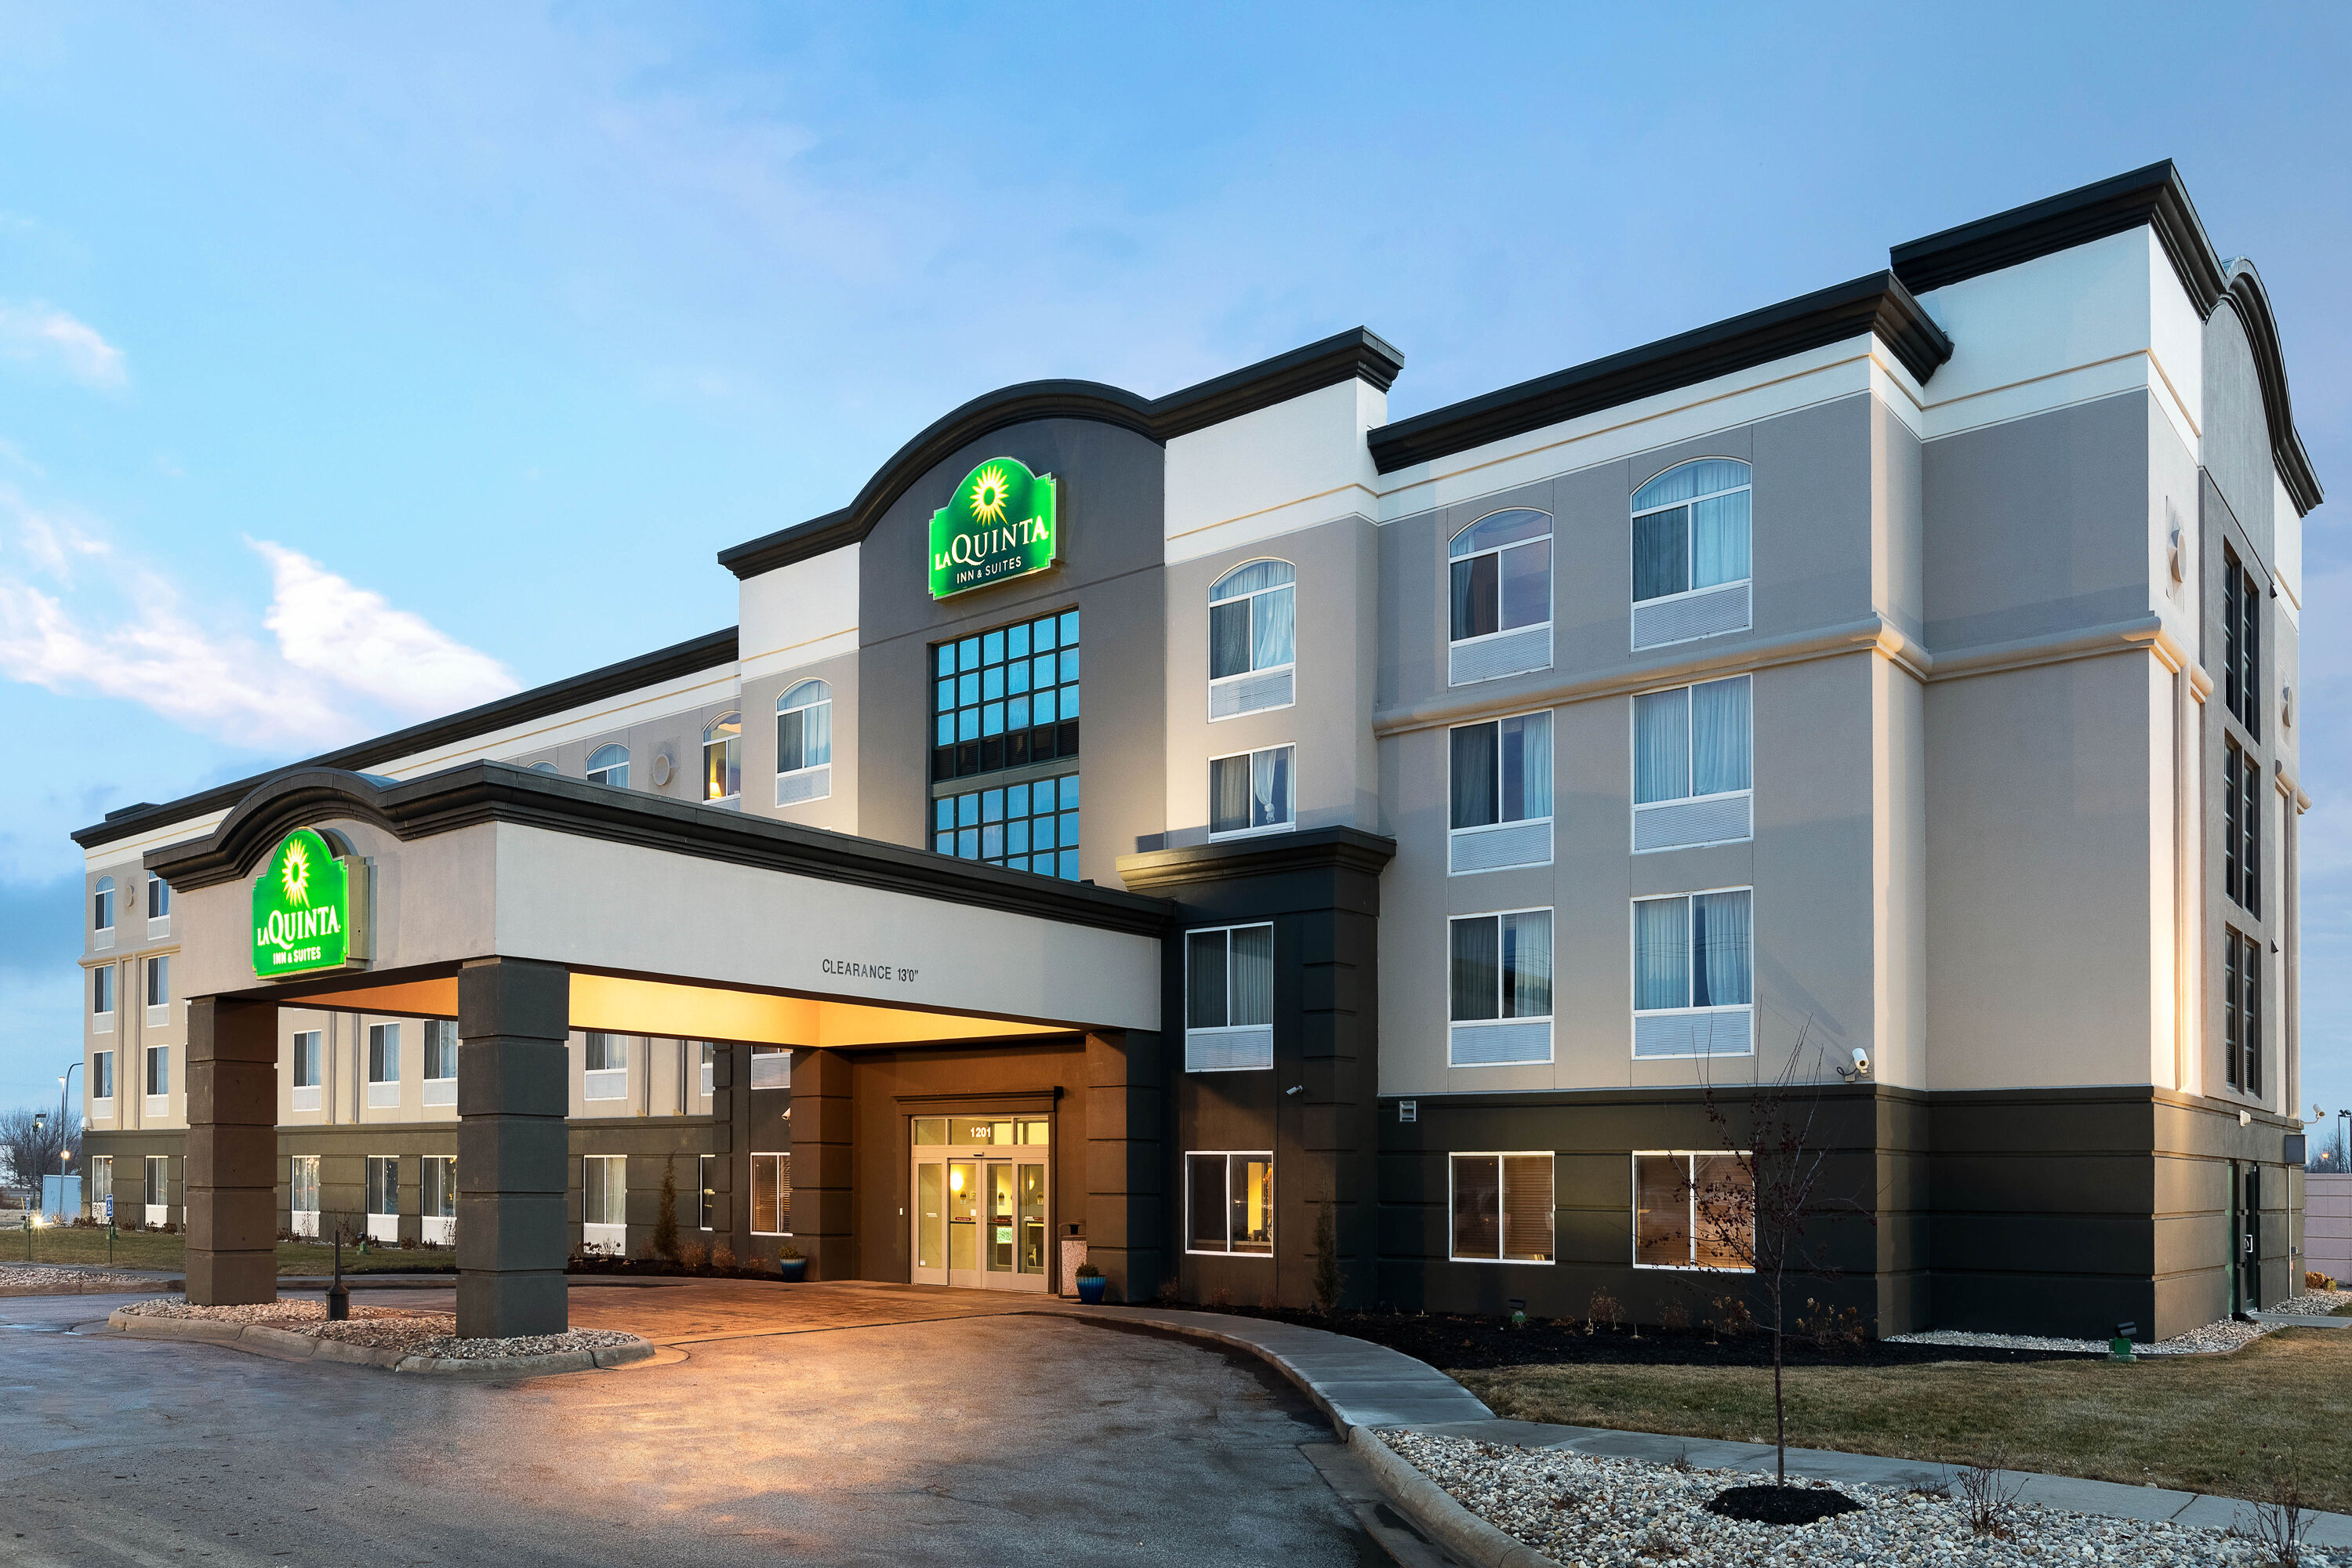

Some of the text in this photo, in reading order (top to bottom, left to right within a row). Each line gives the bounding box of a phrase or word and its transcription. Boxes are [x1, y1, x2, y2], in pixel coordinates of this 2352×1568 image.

[935, 515, 1048, 571] LA QUINTA
[956, 556, 1022, 584] INN & SUITES
[257, 905, 340, 949] LA QUINTA
[273, 946, 321, 965] INN & SUITES
[822, 959, 891, 980] CLEARANCE
[970, 1127, 991, 1138] 1201
